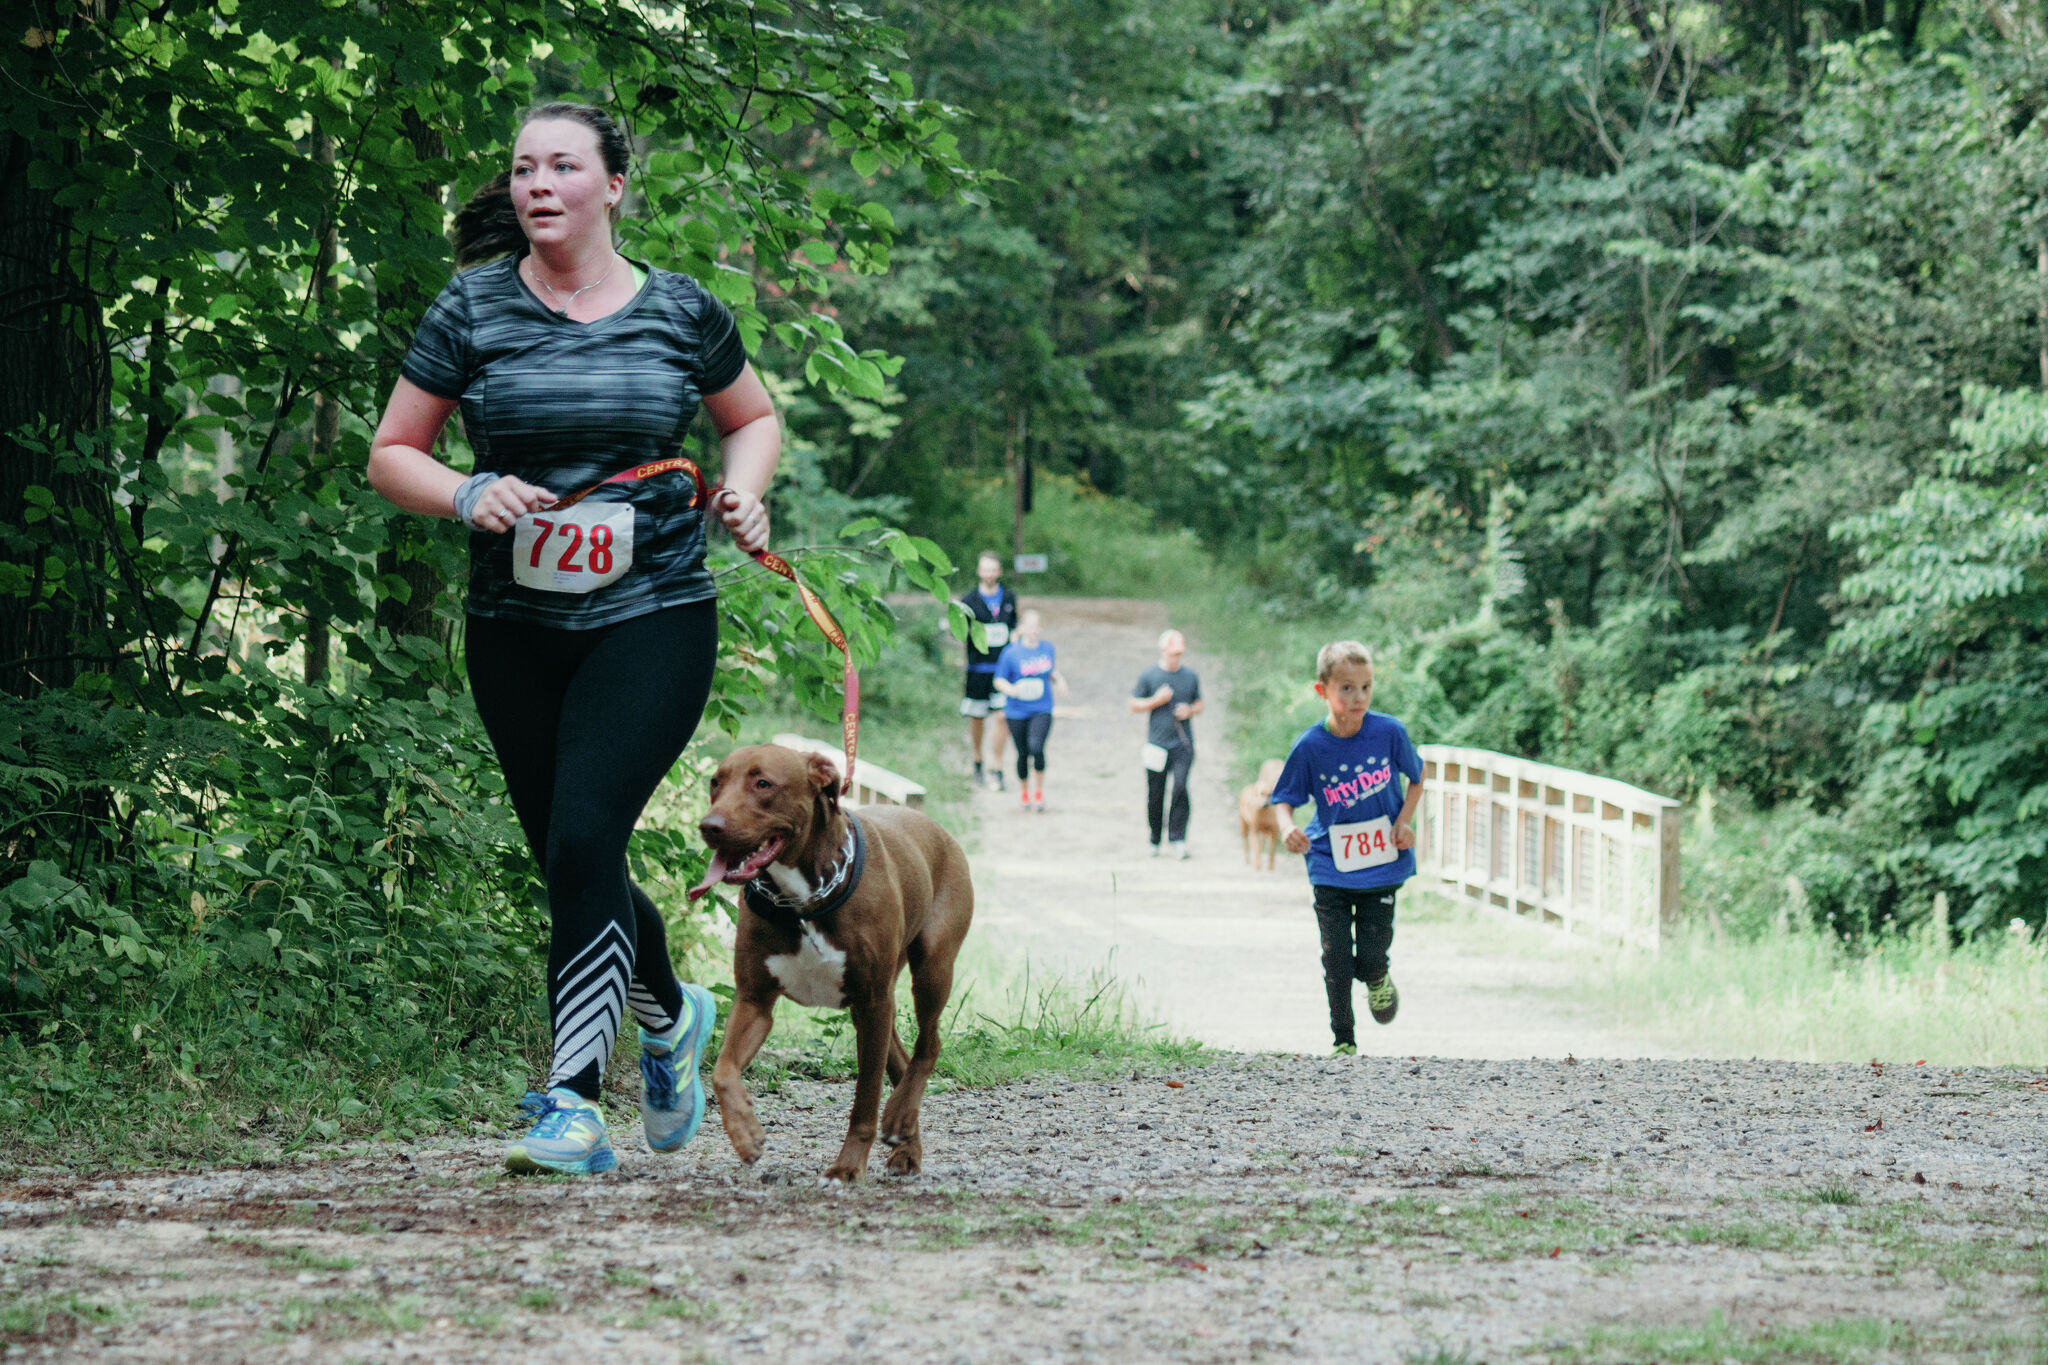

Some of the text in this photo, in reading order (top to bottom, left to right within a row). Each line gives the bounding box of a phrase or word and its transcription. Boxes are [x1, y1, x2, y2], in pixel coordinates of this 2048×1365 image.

[530, 518, 613, 574] 728
[1358, 765, 1391, 791] Dog
[1341, 829, 1386, 859] 784
